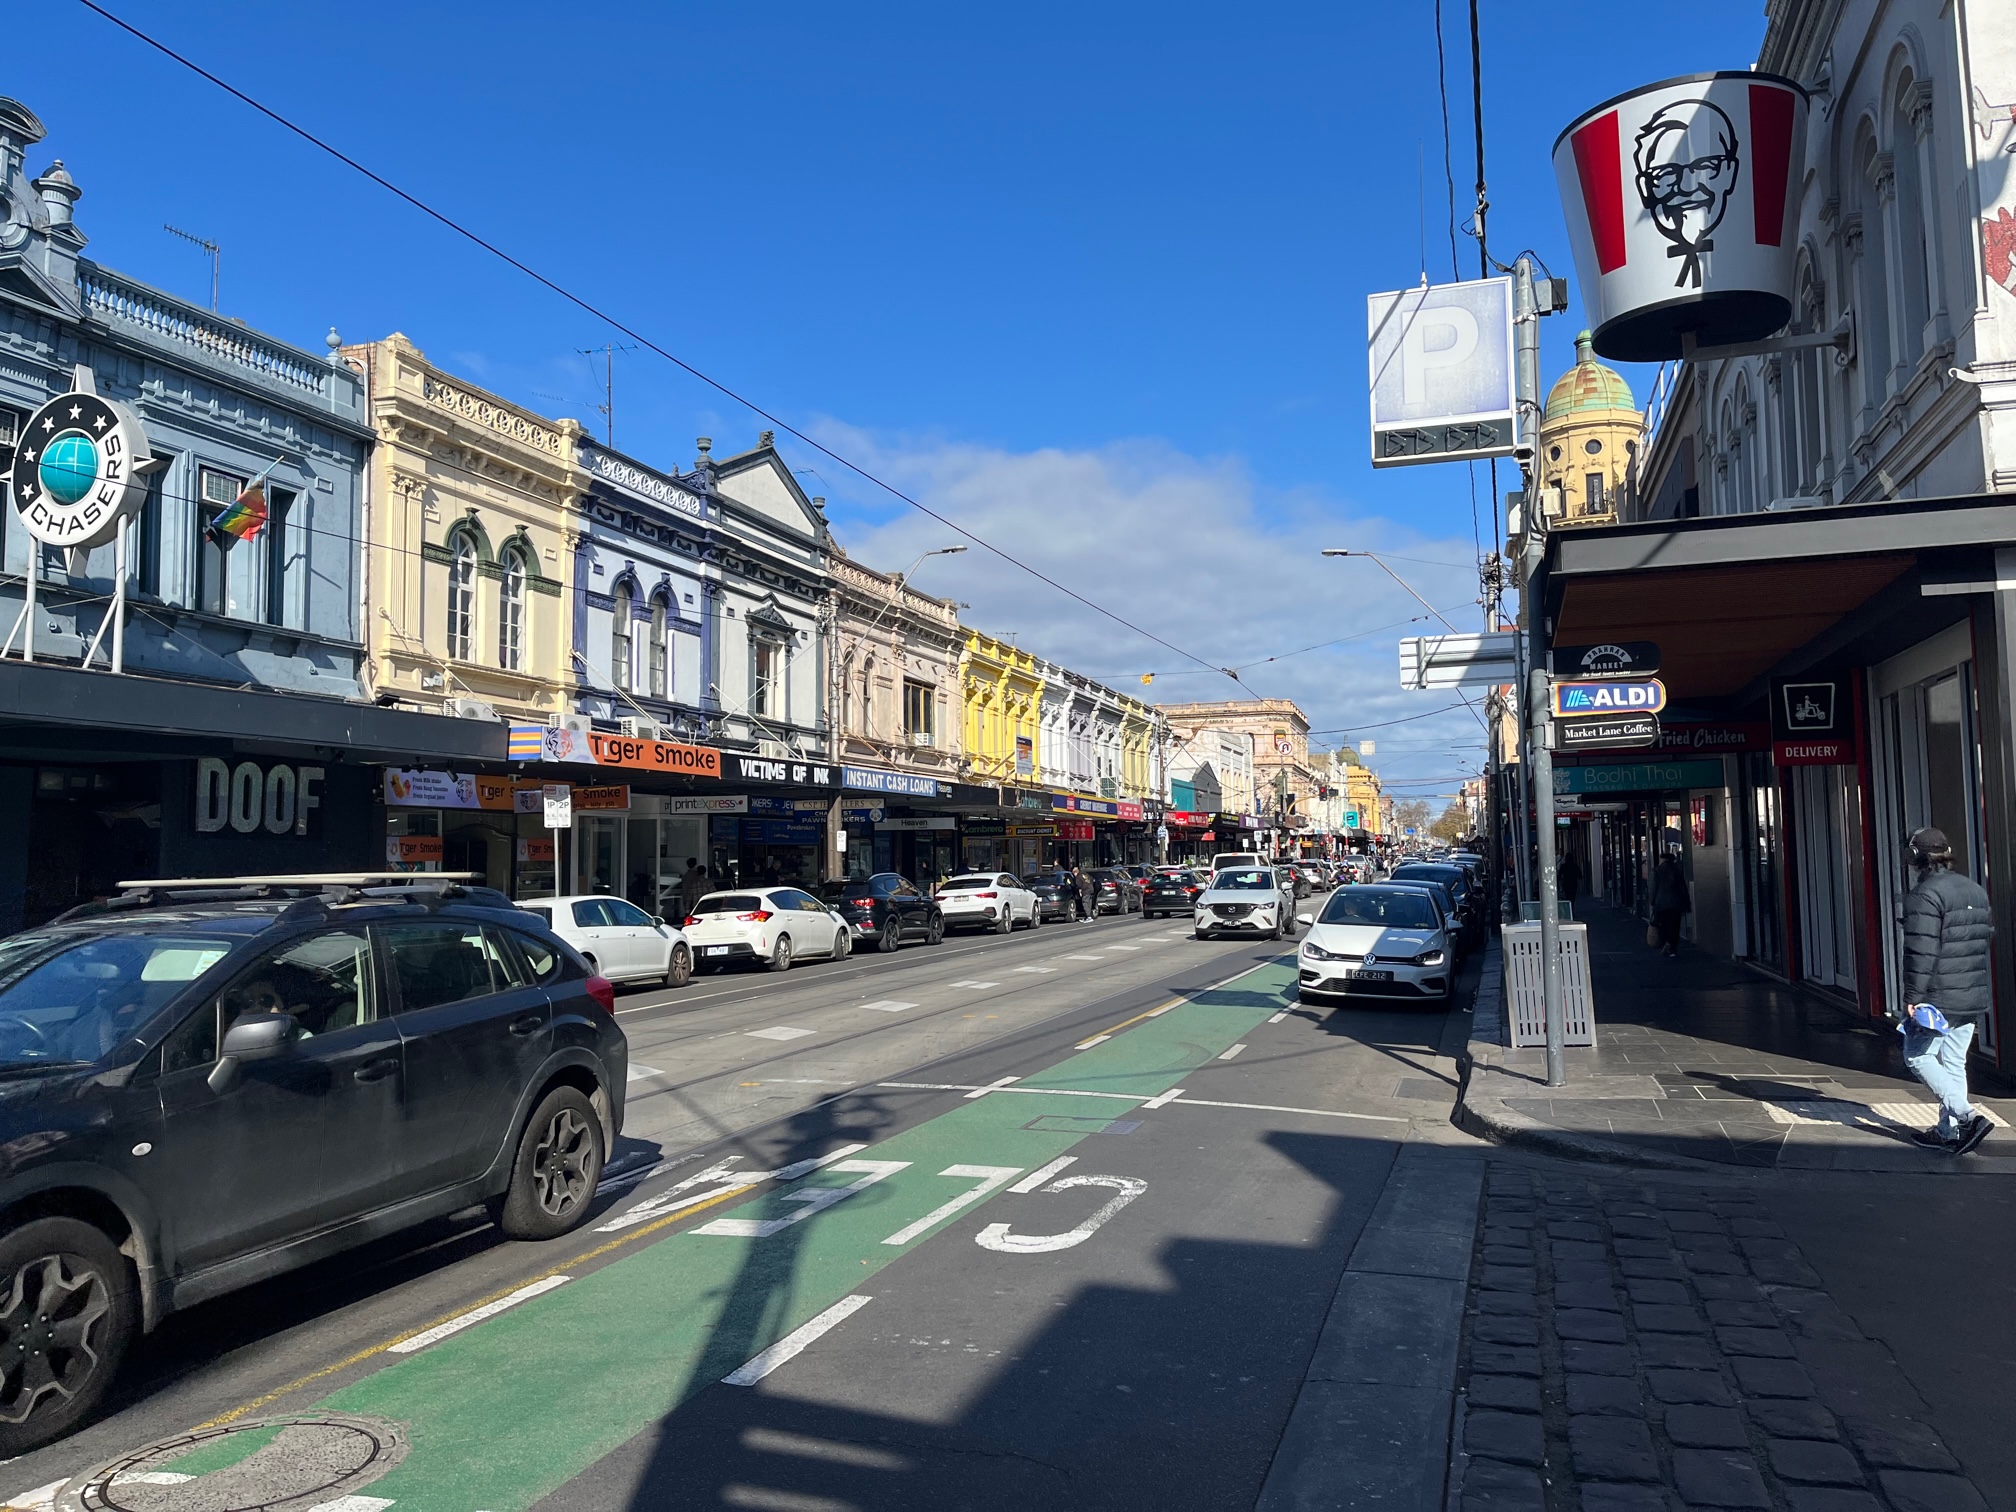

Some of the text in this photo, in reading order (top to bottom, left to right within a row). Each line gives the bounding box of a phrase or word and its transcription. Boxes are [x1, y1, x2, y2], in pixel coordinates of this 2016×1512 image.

[1402, 306, 1479, 405] P
[30, 433, 122, 537] CHASERS
[1587, 645, 1626, 661] PRAHRAN
[1589, 661, 1624, 670] MARKET
[1593, 686, 1655, 707] ALDI
[1565, 724, 1653, 739] Market Lane Coffee
[1658, 728, 1746, 748] Fried Chicken
[590, 735, 716, 769] Tiger Smoke
[1785, 746, 1838, 758] DELIVERY
[739, 758, 829, 785] VICTIMS OF INK
[1584, 764, 1682, 784] Bodhi Thai
[480, 784, 505, 800] Tiger
[583, 787, 621, 799] Smoke
[1585, 784, 1629, 792] MASSAGE
[195, 757, 326, 836] DOOF
[547, 801, 556, 809] 1P
[558, 801, 570, 809] 2P
[674, 797, 736, 812] printexpress
[901, 819, 928, 827] Heaven
[400, 842, 442, 856] Tiger Smoke
[1371, 972, 1386, 980] 212
